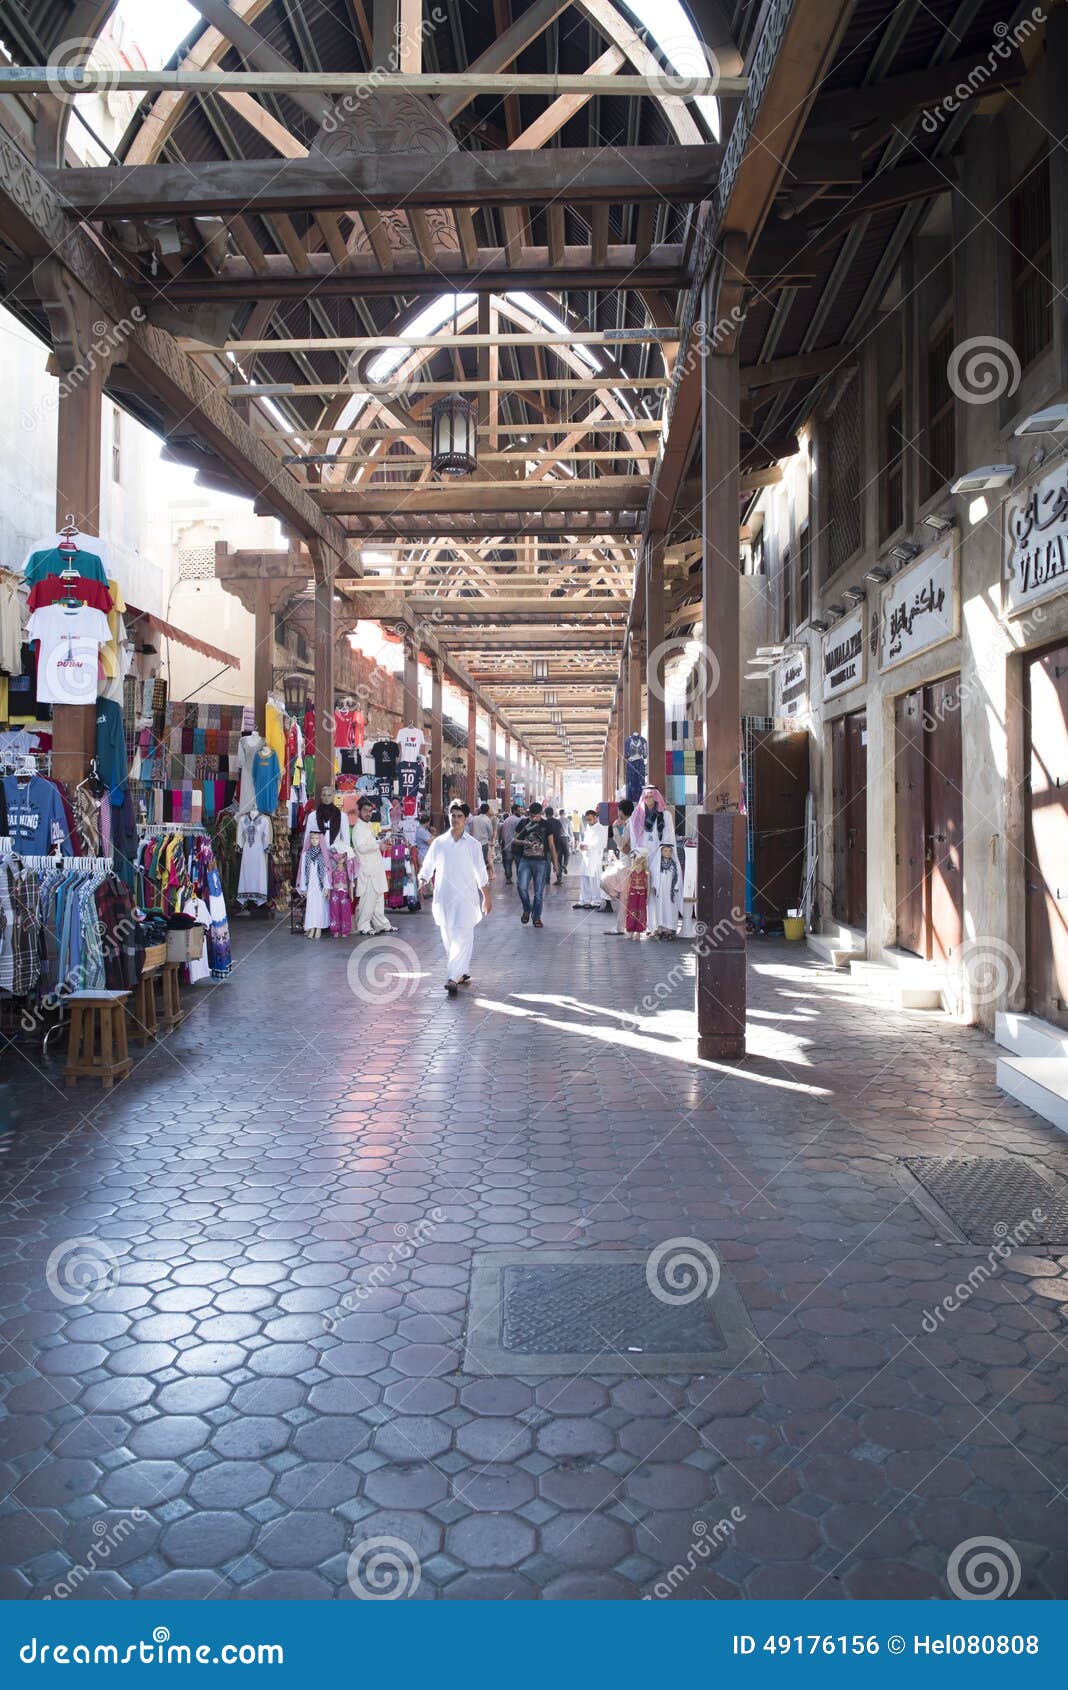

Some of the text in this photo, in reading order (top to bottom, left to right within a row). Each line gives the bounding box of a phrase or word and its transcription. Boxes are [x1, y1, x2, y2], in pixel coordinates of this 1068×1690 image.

[1020, 534, 1068, 593] VIJA
[403, 773, 415, 784] 10
[381, 786, 390, 794] 10
